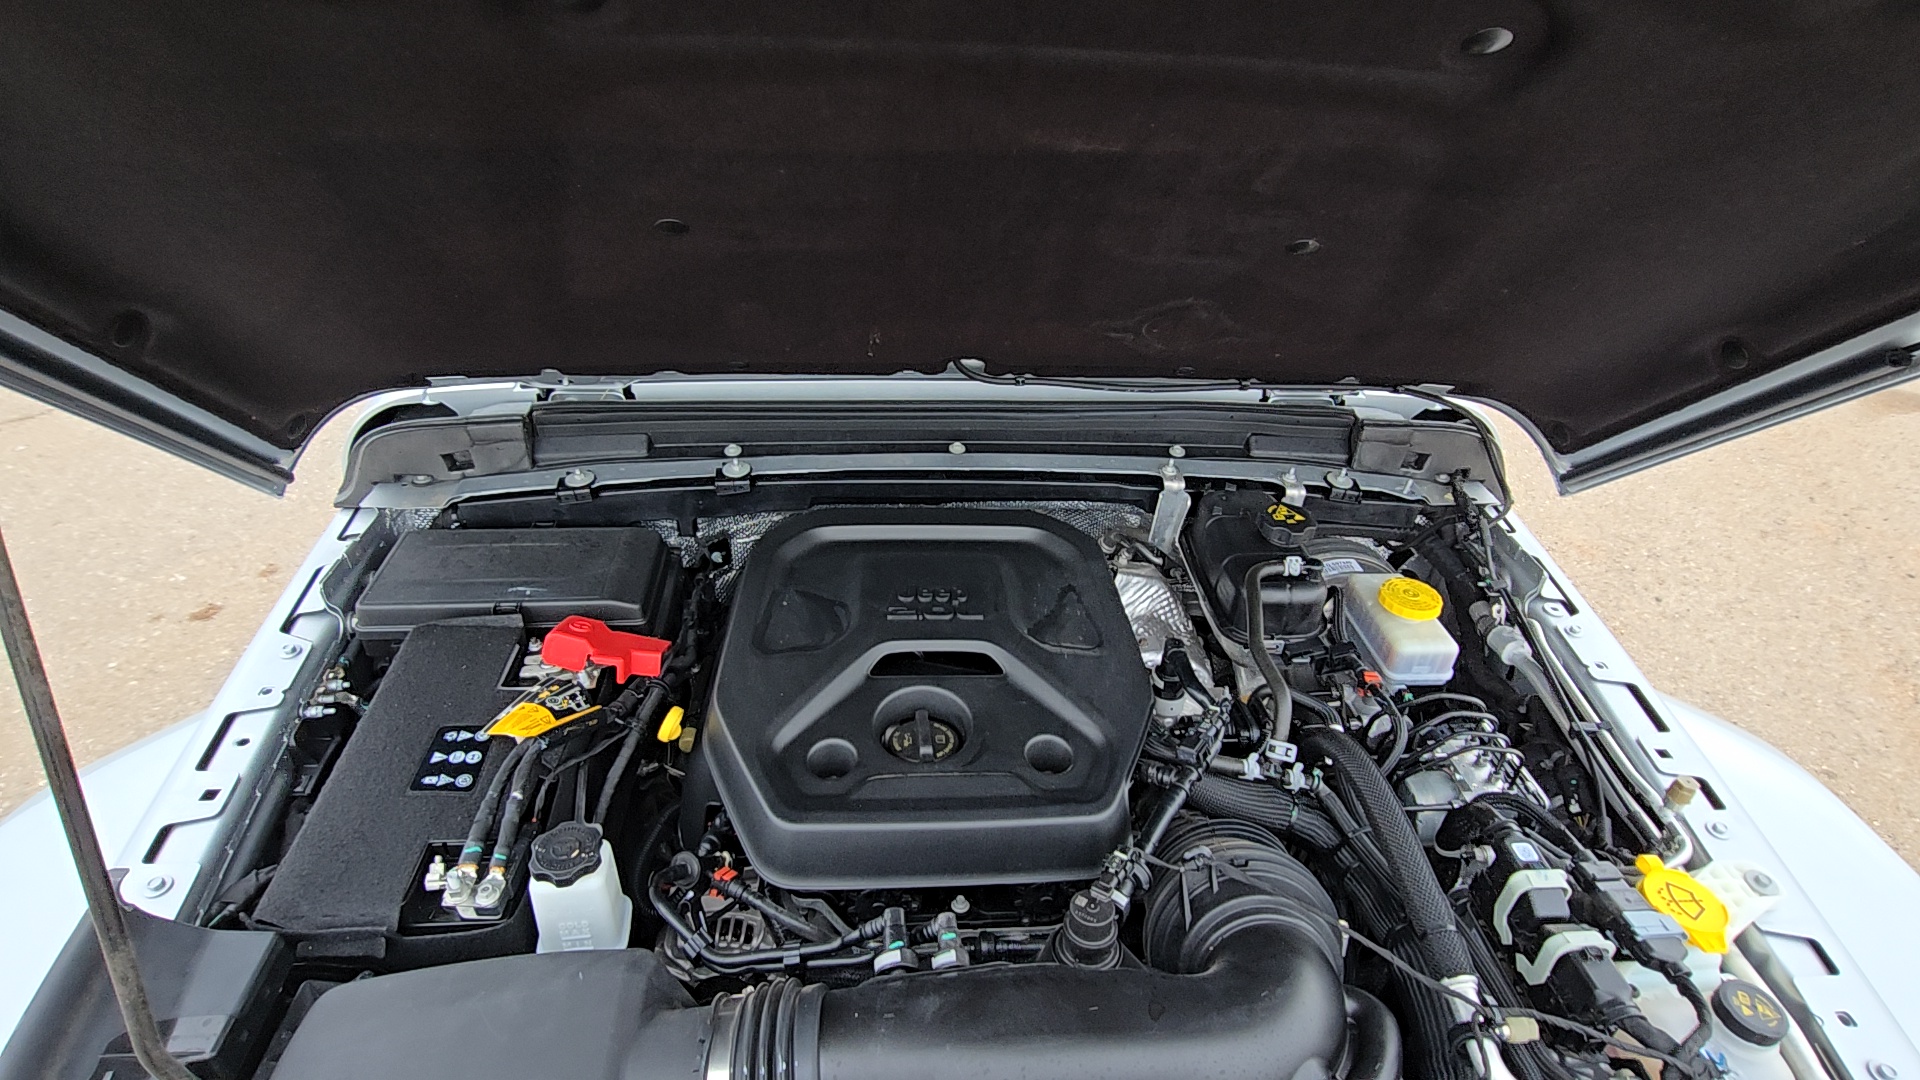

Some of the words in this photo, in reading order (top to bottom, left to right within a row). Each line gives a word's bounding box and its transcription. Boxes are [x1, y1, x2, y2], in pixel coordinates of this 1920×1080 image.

[897, 586, 968, 606] Jeep
[886, 606, 984, 620] 2.0L
[559, 920, 589, 930] COLD
[562, 940, 592, 949] MIN
